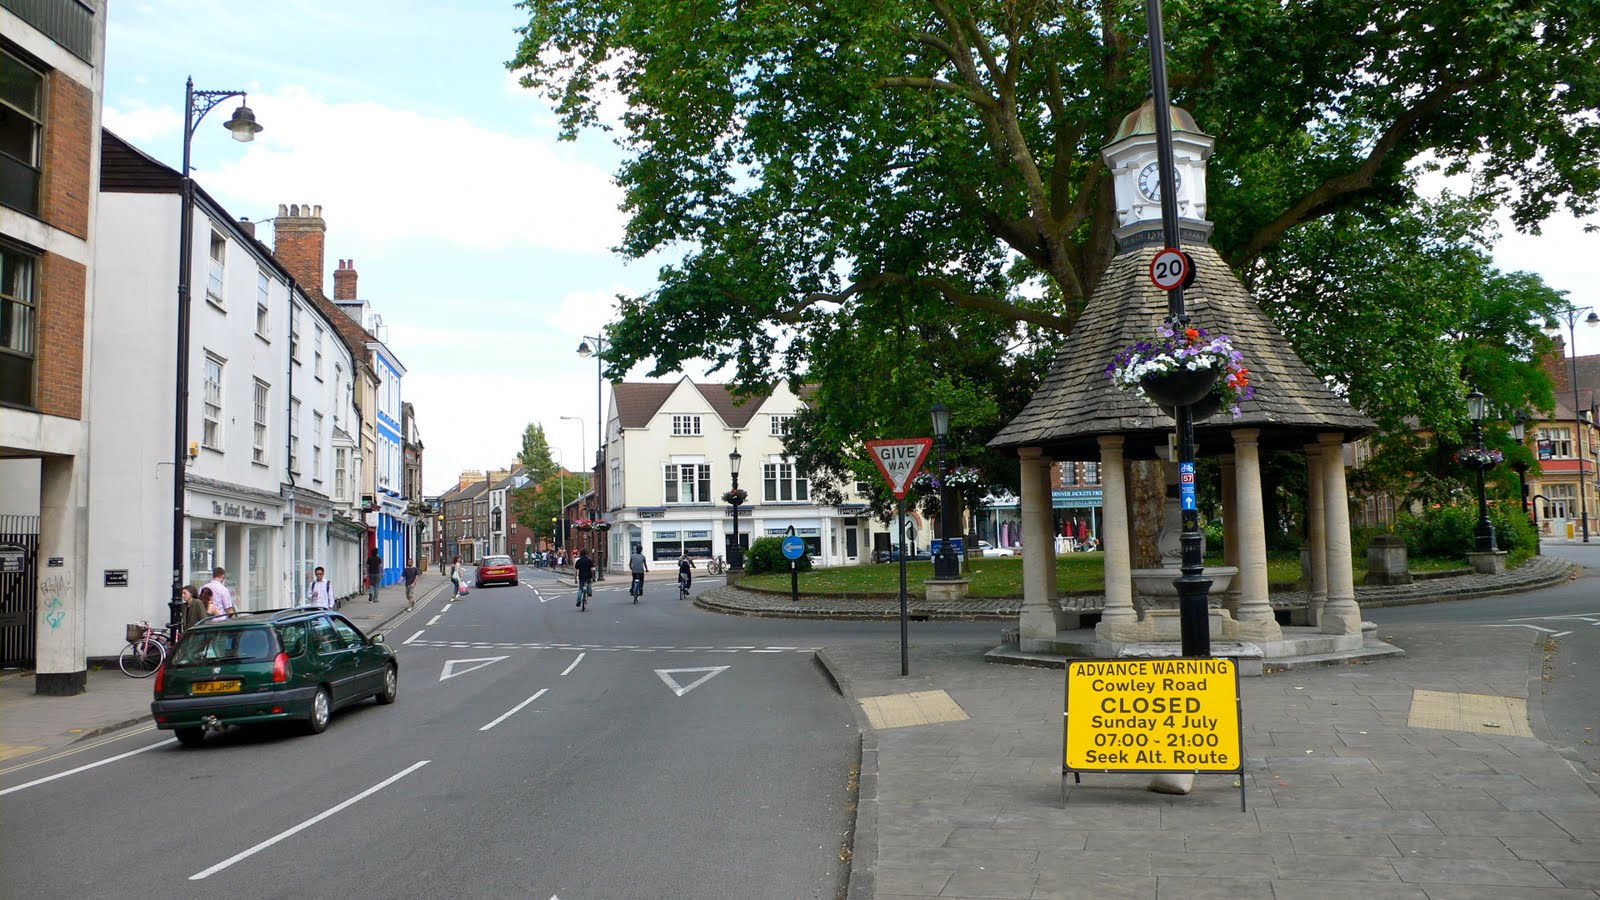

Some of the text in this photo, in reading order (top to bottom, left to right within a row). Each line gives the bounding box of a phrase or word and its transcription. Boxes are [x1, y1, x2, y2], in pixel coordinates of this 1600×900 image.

[1156, 259, 1182, 279] 20
[881, 446, 915, 460] GIVE
[888, 461, 911, 470] WAY
[1076, 661, 1228, 676] ADVANCE WARNING
[1092, 678, 1207, 693] Cowley Road
[1101, 697, 1201, 713] CLOSED
[1091, 715, 1218, 731] Sunday 4 July
[1094, 733, 1149, 747] 07:00
[1166, 733, 1219, 747] 21:00
[1085, 750, 1228, 764] Seek Alt. Route
